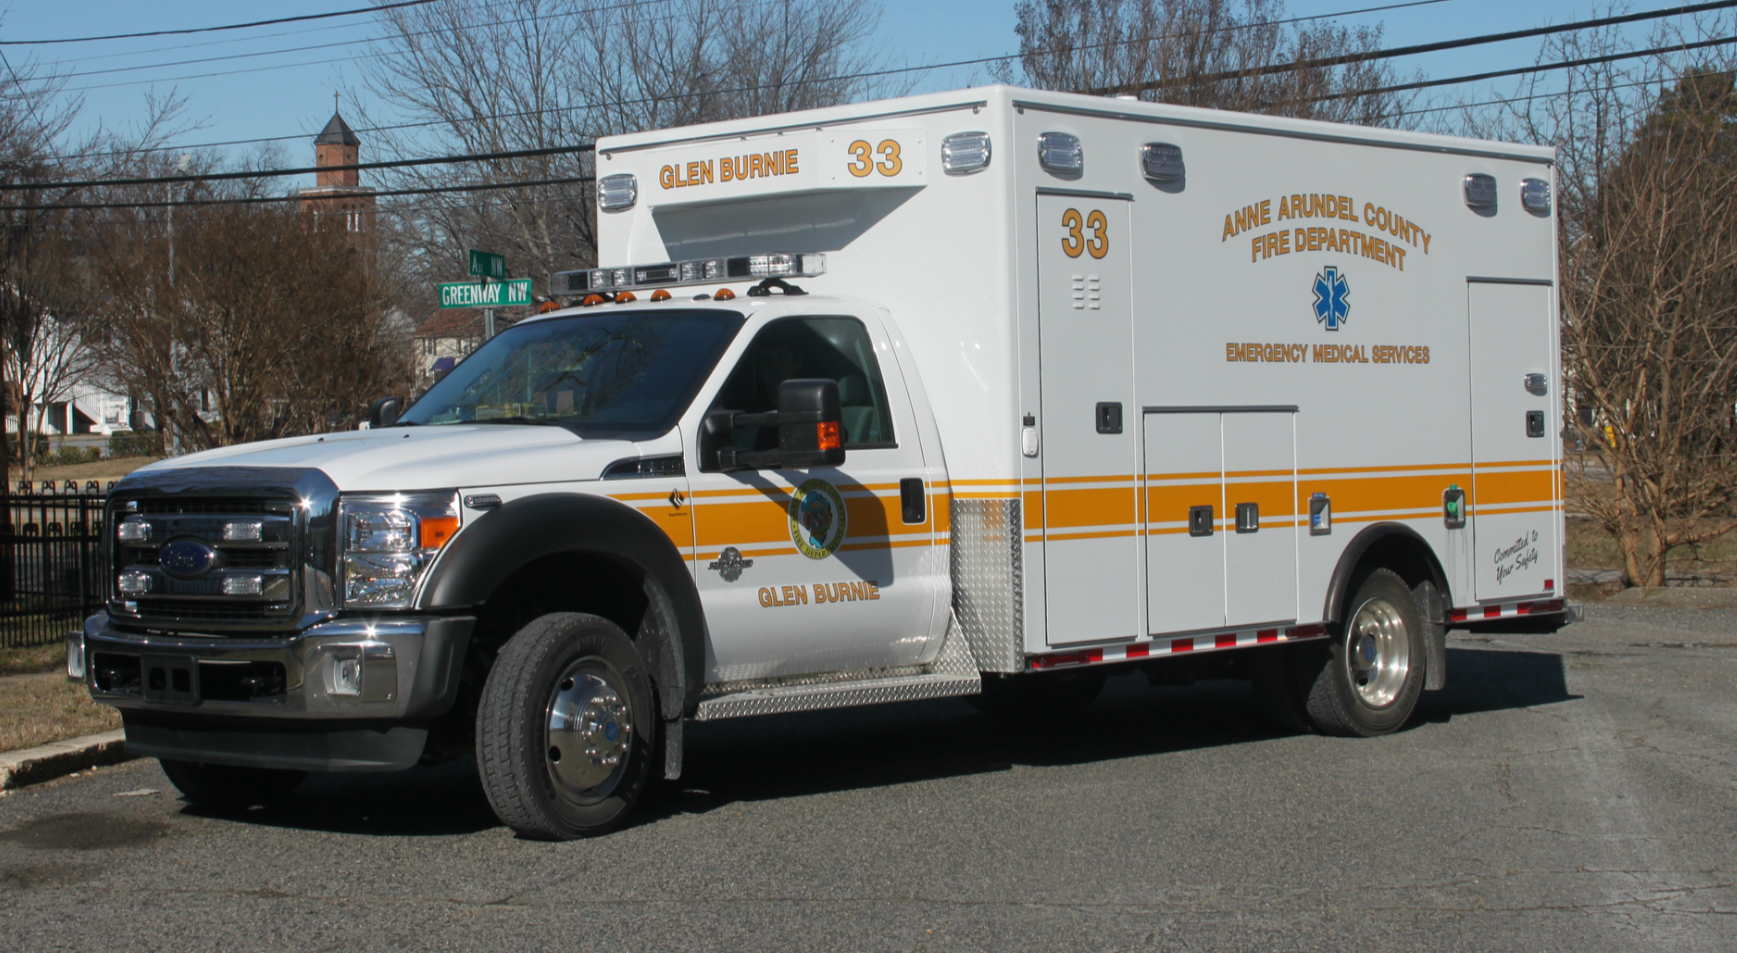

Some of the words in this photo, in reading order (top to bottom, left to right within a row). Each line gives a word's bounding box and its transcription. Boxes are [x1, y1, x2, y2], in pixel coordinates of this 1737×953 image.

[659, 159, 714, 190] GLEN
[720, 148, 799, 183] BURNIE
[847, 139, 903, 178] 33
[1061, 207, 1109, 260] 33
[1222, 199, 1271, 243] ANNE
[1278, 193, 1359, 223] ARUNDEL
[1364, 202, 1432, 255] COUNTY
[491, 255, 503, 277] NW
[1252, 229, 1290, 263] FIRE
[1295, 227, 1406, 272] DEPARTMENT
[442, 283, 502, 306] GREENWAY
[508, 281, 528, 303] NW
[1226, 343, 1308, 363] EMERGENCY
[1312, 344, 1369, 364] MEDICAL
[1372, 345, 1431, 365] SERVICES
[1494, 530, 1529, 564] Committed
[1531, 529, 1538, 543] to
[1496, 563, 1514, 586] Your
[1515, 547, 1538, 570] Safety
[758, 585, 808, 608] GLEN
[813, 580, 881, 604] BURNIE
